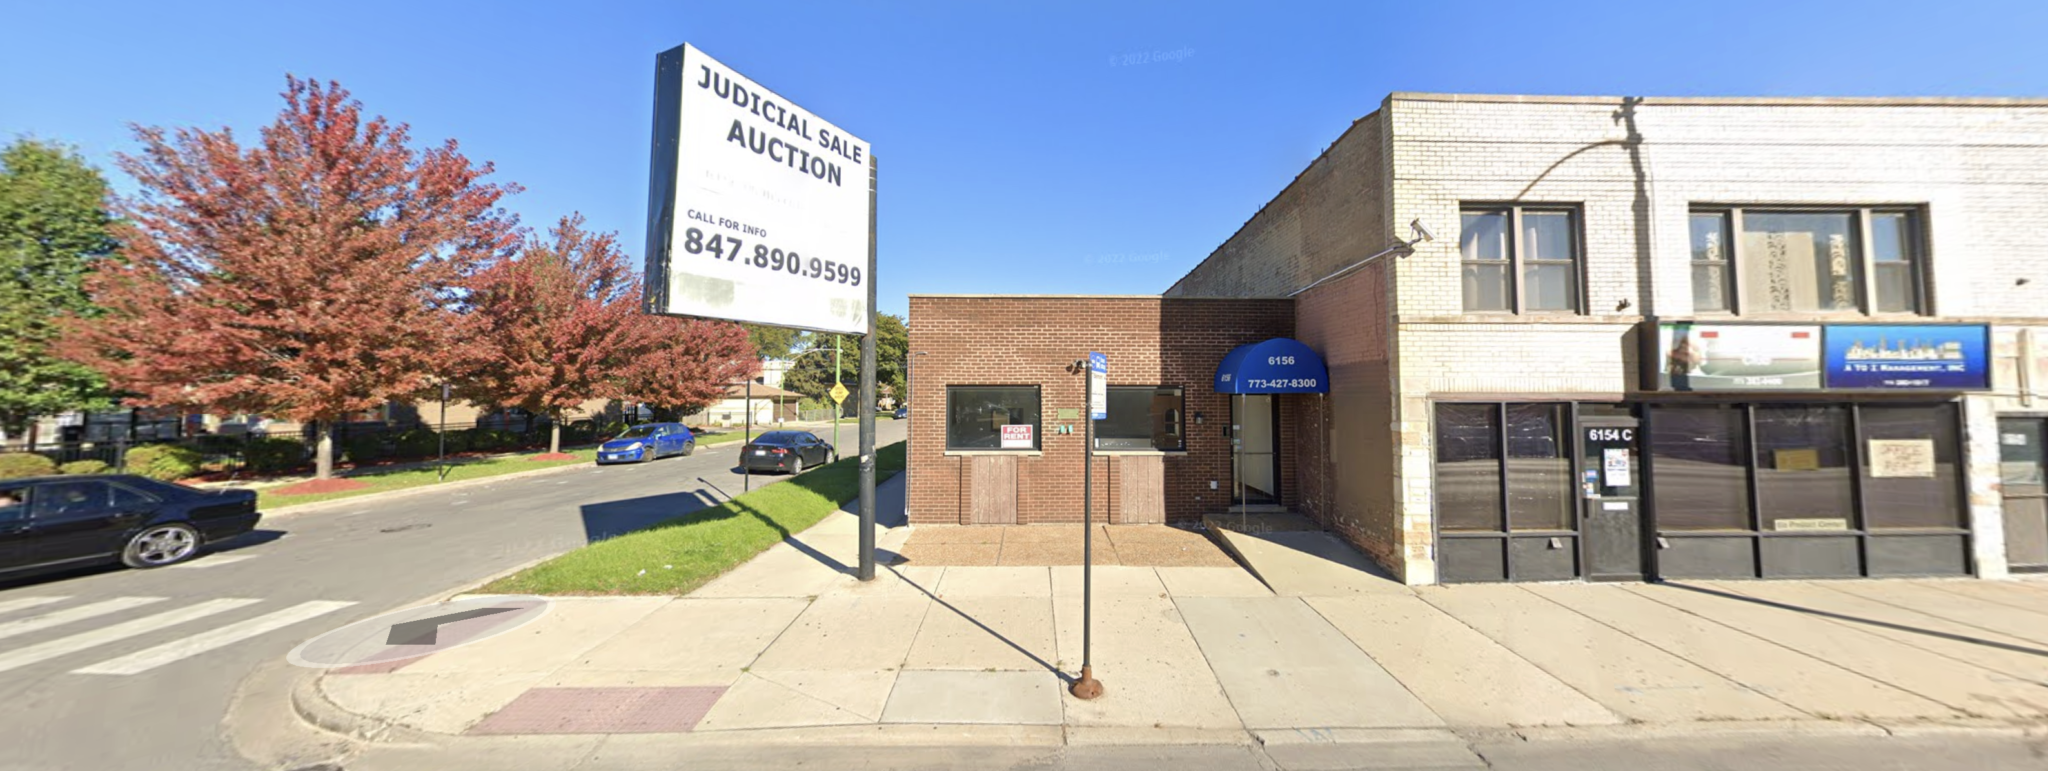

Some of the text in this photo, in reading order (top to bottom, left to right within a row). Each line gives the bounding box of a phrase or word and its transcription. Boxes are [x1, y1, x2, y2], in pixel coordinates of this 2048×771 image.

[697, 64, 862, 165] JUDICIAL SALE
[726, 118, 842, 187] AUCTION
[687, 209, 767, 238] CALL FOR INFO
[684, 226, 861, 286] 847.890.9599
[1267, 356, 1295, 365] 6156
[1248, 379, 1317, 388] 773-427-8300
[1006, 426, 1028, 434] FOR
[1589, 429, 1633, 441] 6154 C
